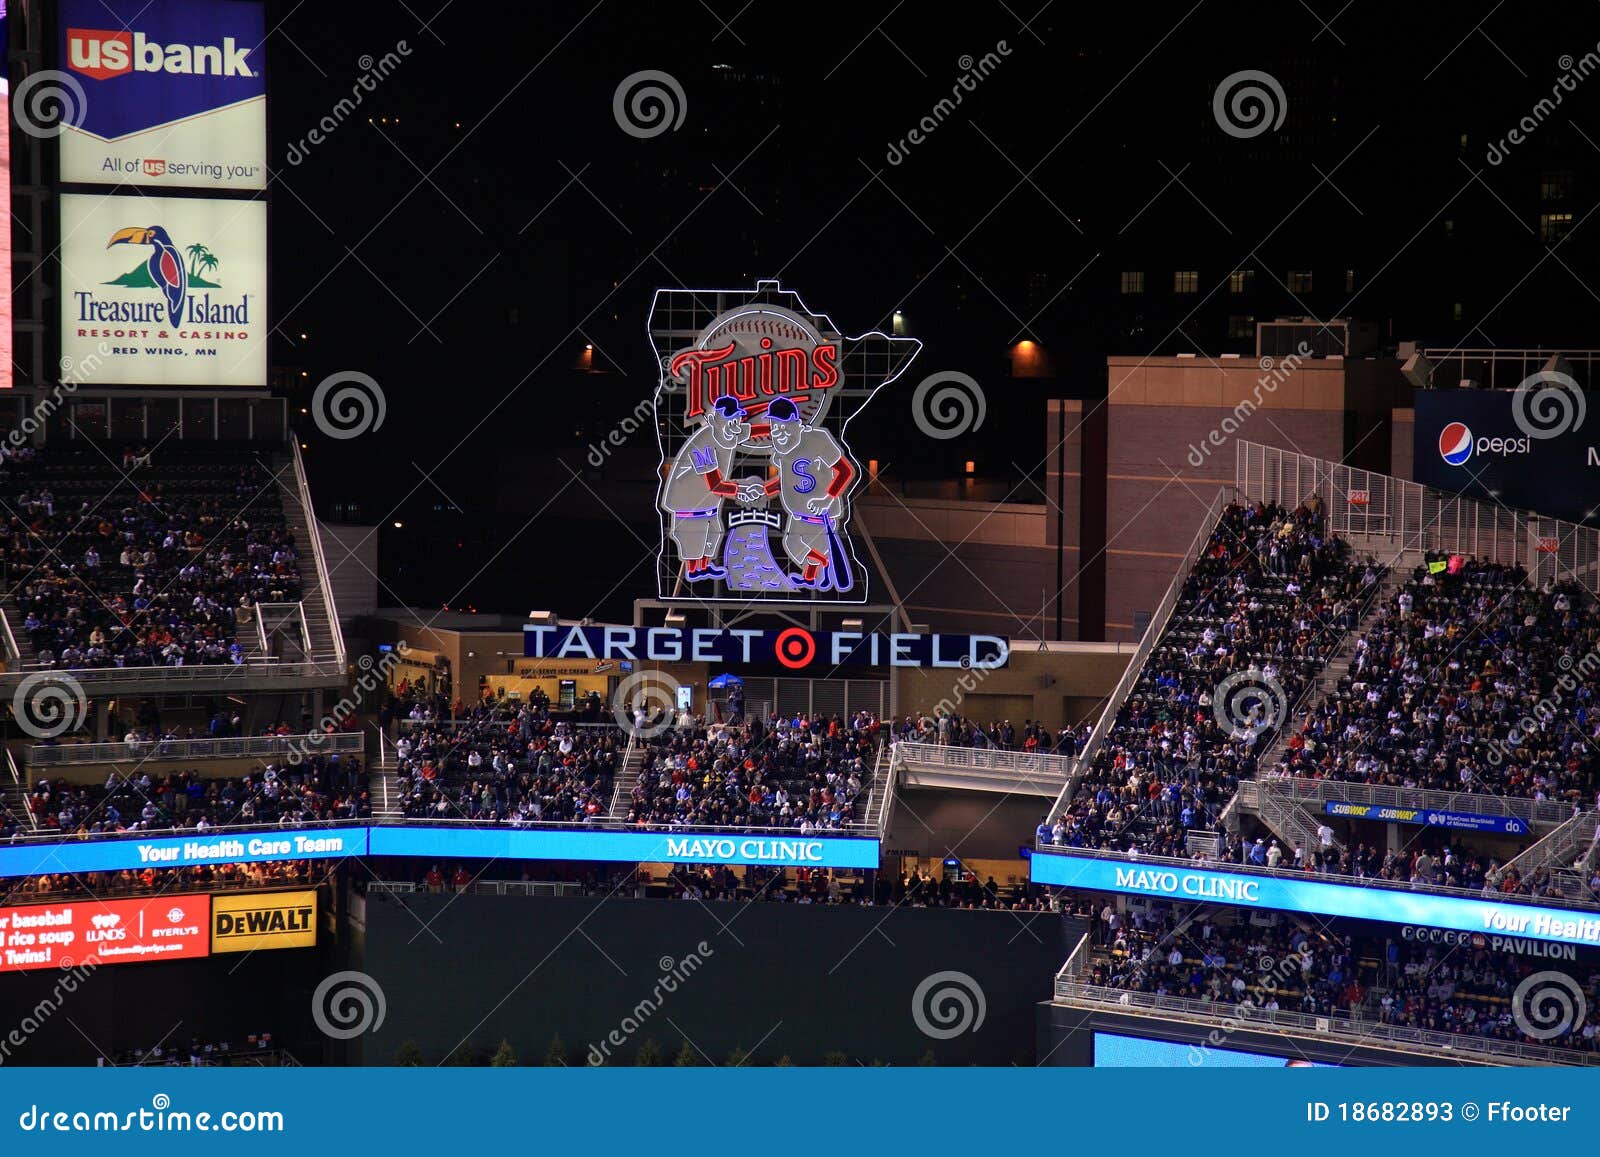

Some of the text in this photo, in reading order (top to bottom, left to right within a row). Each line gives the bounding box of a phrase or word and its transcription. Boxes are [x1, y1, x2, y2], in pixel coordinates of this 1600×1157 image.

[102, 157, 121, 172] All
[125, 158, 140, 172] of
[144, 161, 164, 174] us
[168, 161, 222, 179] serving
[74, 291, 249, 324] Treasure Island
[77, 329, 249, 340] RESORT & CASINO
[112, 347, 138, 355] RED
[671, 338, 839, 417] Twins
[1477, 435, 1530, 456] pepsi
[523, 624, 1009, 669] TARGET FIELD
[1332, 804, 1370, 817] SUBWAY
[1379, 808, 1418, 821] SUBWAY
[138, 836, 343, 862] Your Health Care Team
[666, 838, 822, 861] MAYO CLINIC
[1115, 868, 1259, 902] MAYO CLINIC
[12, 908, 72, 928] baseball
[1483, 907, 1530, 933] Your
[8, 930, 35, 946] rice
[39, 930, 75, 946] soup
[86, 927, 126, 942] LUNDS
[152, 926, 199, 938] BYERLY'S
[5, 947, 51, 965] Twins!
[1491, 936, 1576, 960] PAVILION
